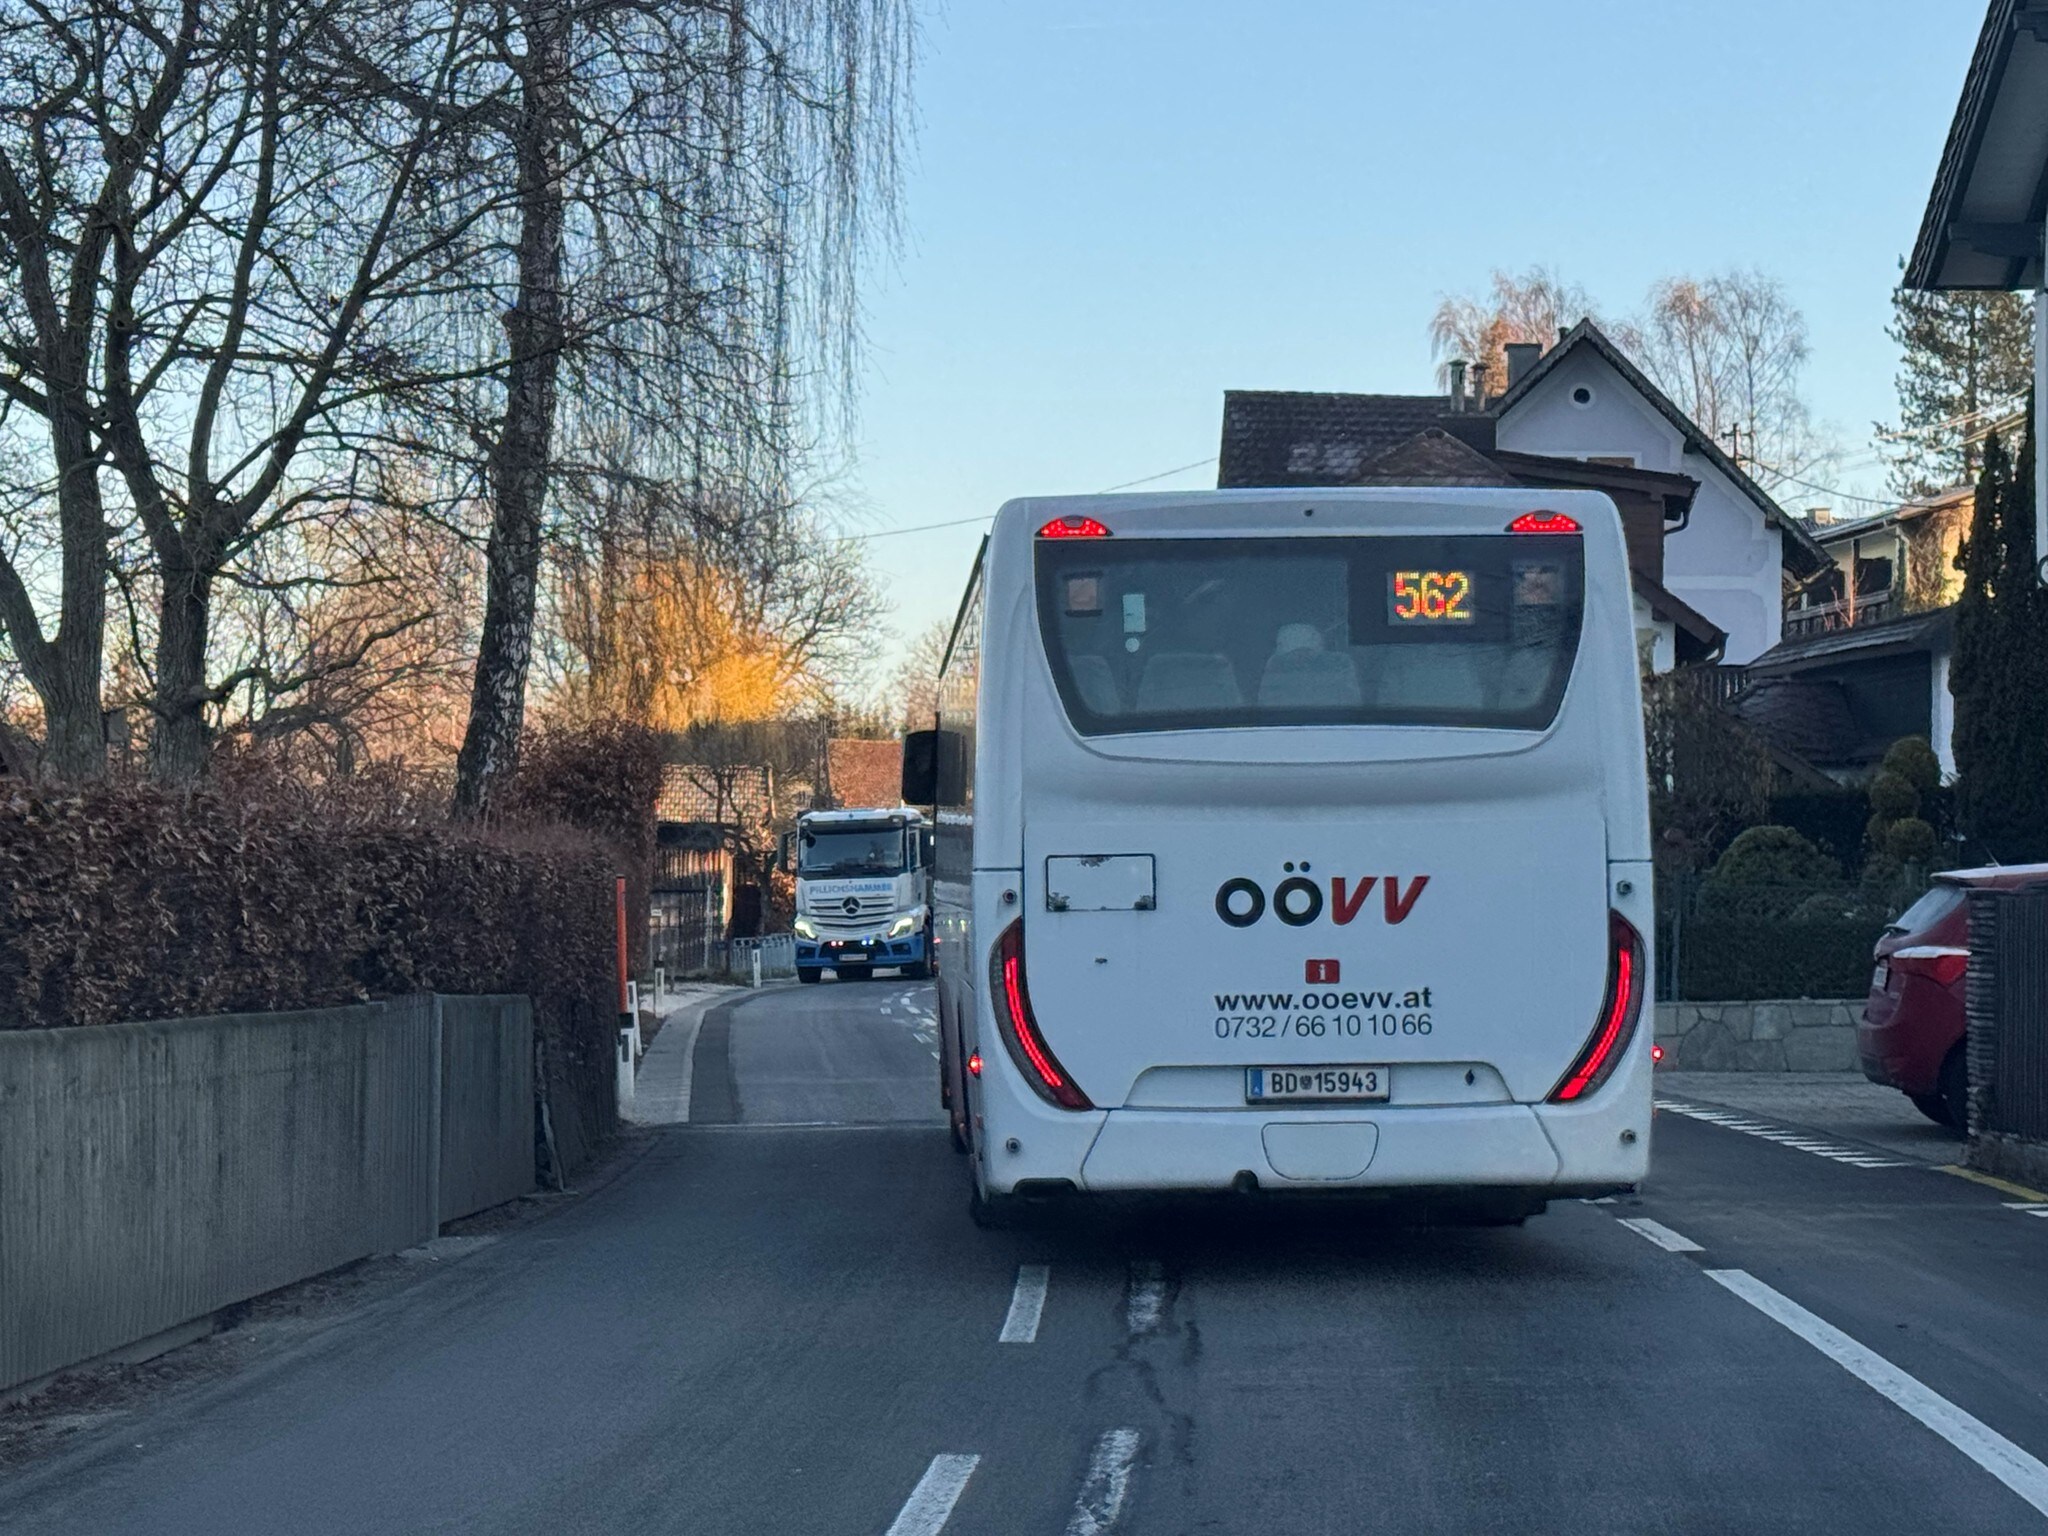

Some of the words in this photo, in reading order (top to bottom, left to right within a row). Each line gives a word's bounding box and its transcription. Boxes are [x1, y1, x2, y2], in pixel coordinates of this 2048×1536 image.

[1395, 571, 1470, 618] 562
[1214, 861, 1431, 928] OÖVV
[1214, 987, 1432, 1011] www.ooevv.at
[1271, 1073, 1297, 1093] BD
[1314, 1072, 1377, 1093] 15943
